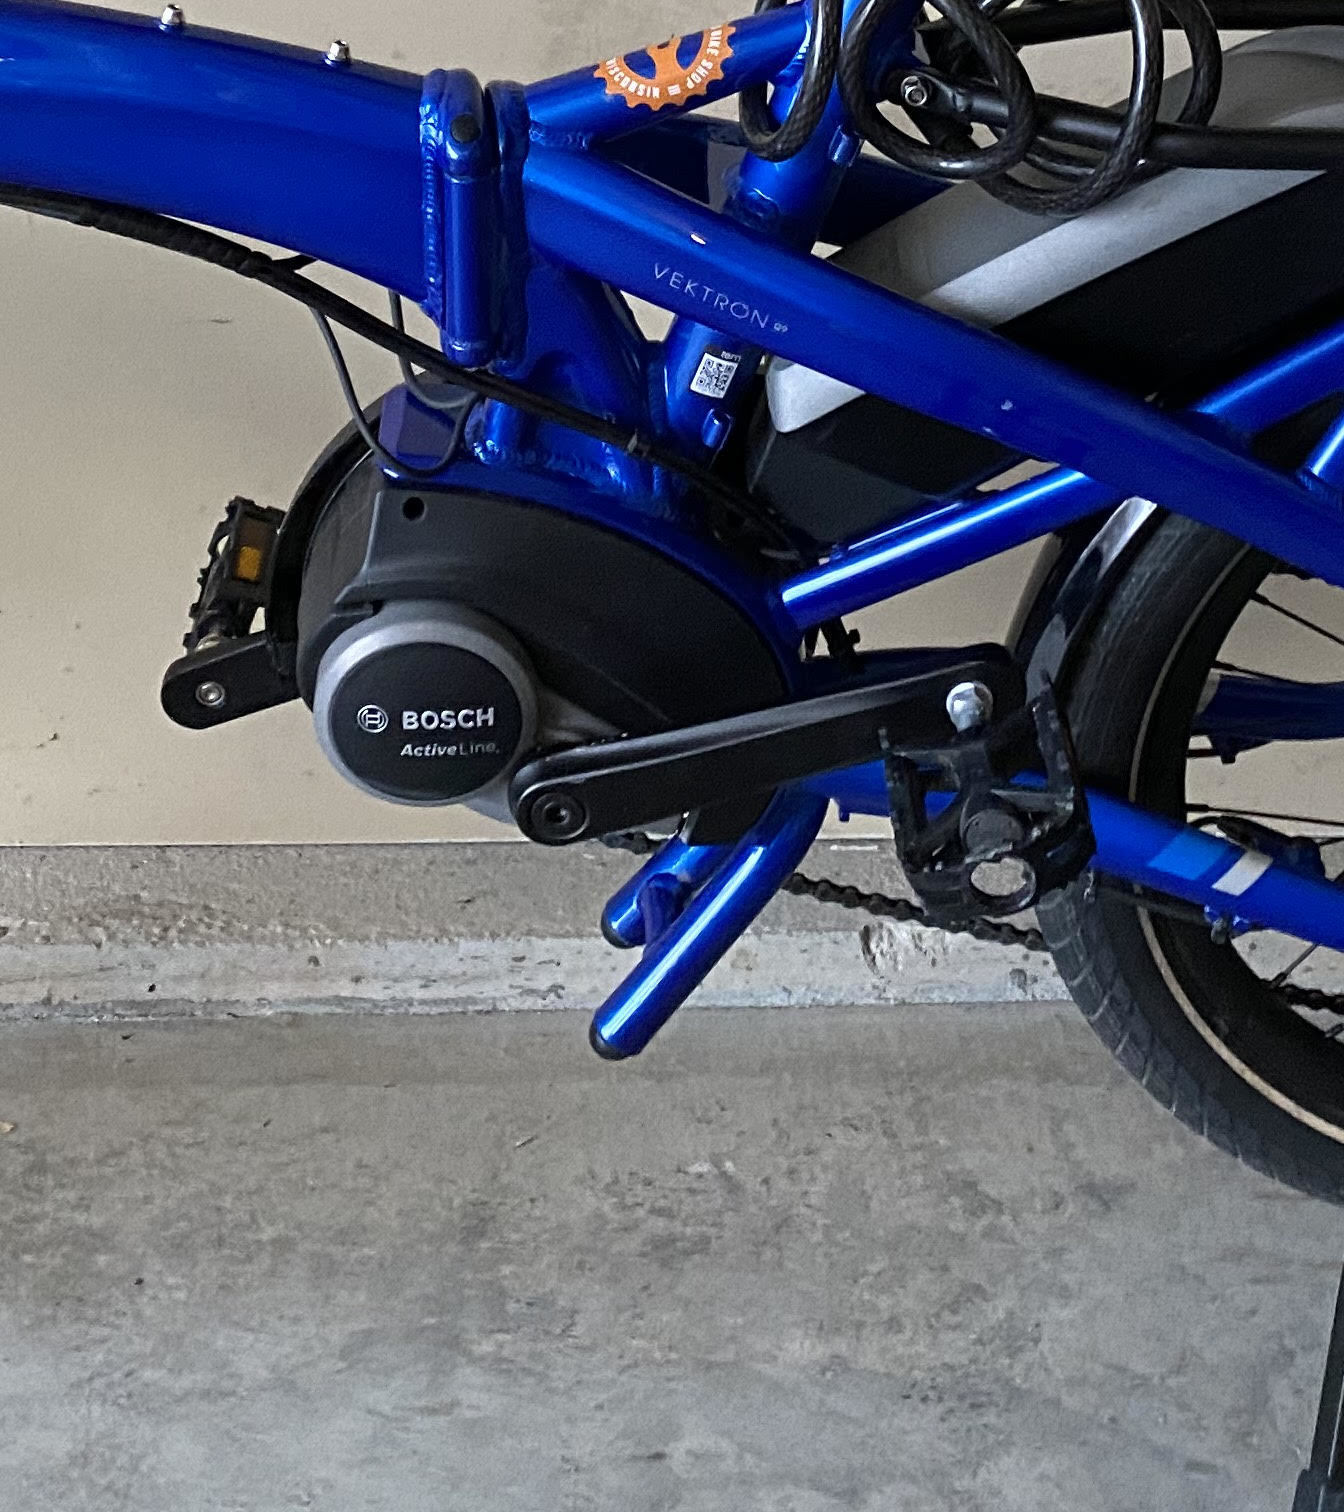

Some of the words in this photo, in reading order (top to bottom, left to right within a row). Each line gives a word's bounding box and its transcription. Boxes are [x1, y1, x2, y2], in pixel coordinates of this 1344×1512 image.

[686, 59, 714, 90] SHOP
[654, 262, 772, 330] VEKTRON
[402, 706, 495, 731] BOSCH
